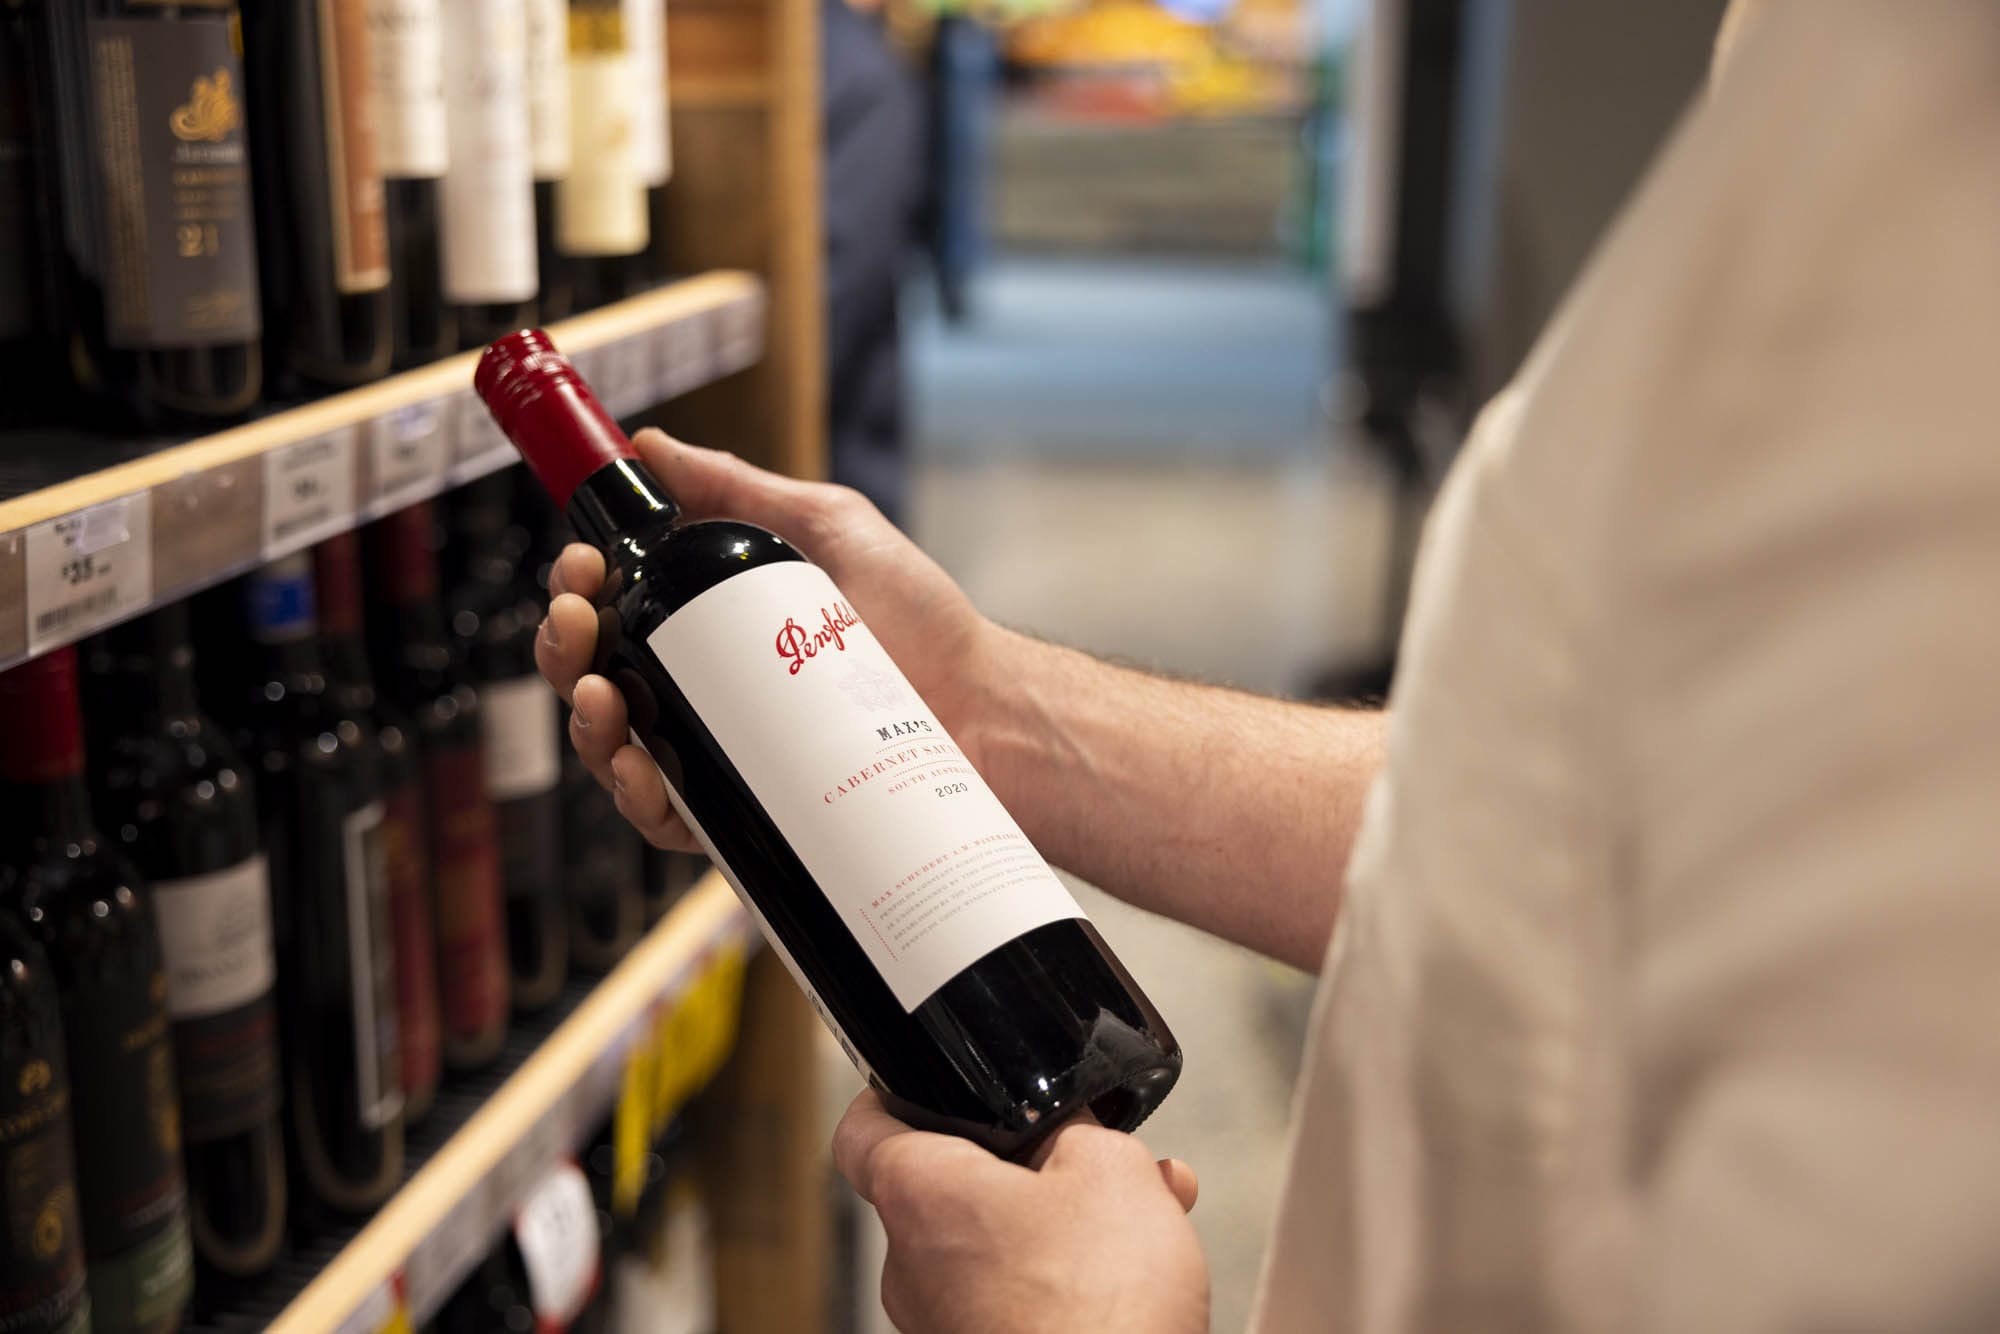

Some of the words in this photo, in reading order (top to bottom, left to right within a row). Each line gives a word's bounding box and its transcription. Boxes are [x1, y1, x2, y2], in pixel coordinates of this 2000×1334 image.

[876, 720, 933, 741] MAX'S
[824, 748, 920, 805] CABERNET
[887, 773, 927, 795] SOUTH
[935, 782, 968, 798] 2020
[872, 890, 893, 908] MAX
